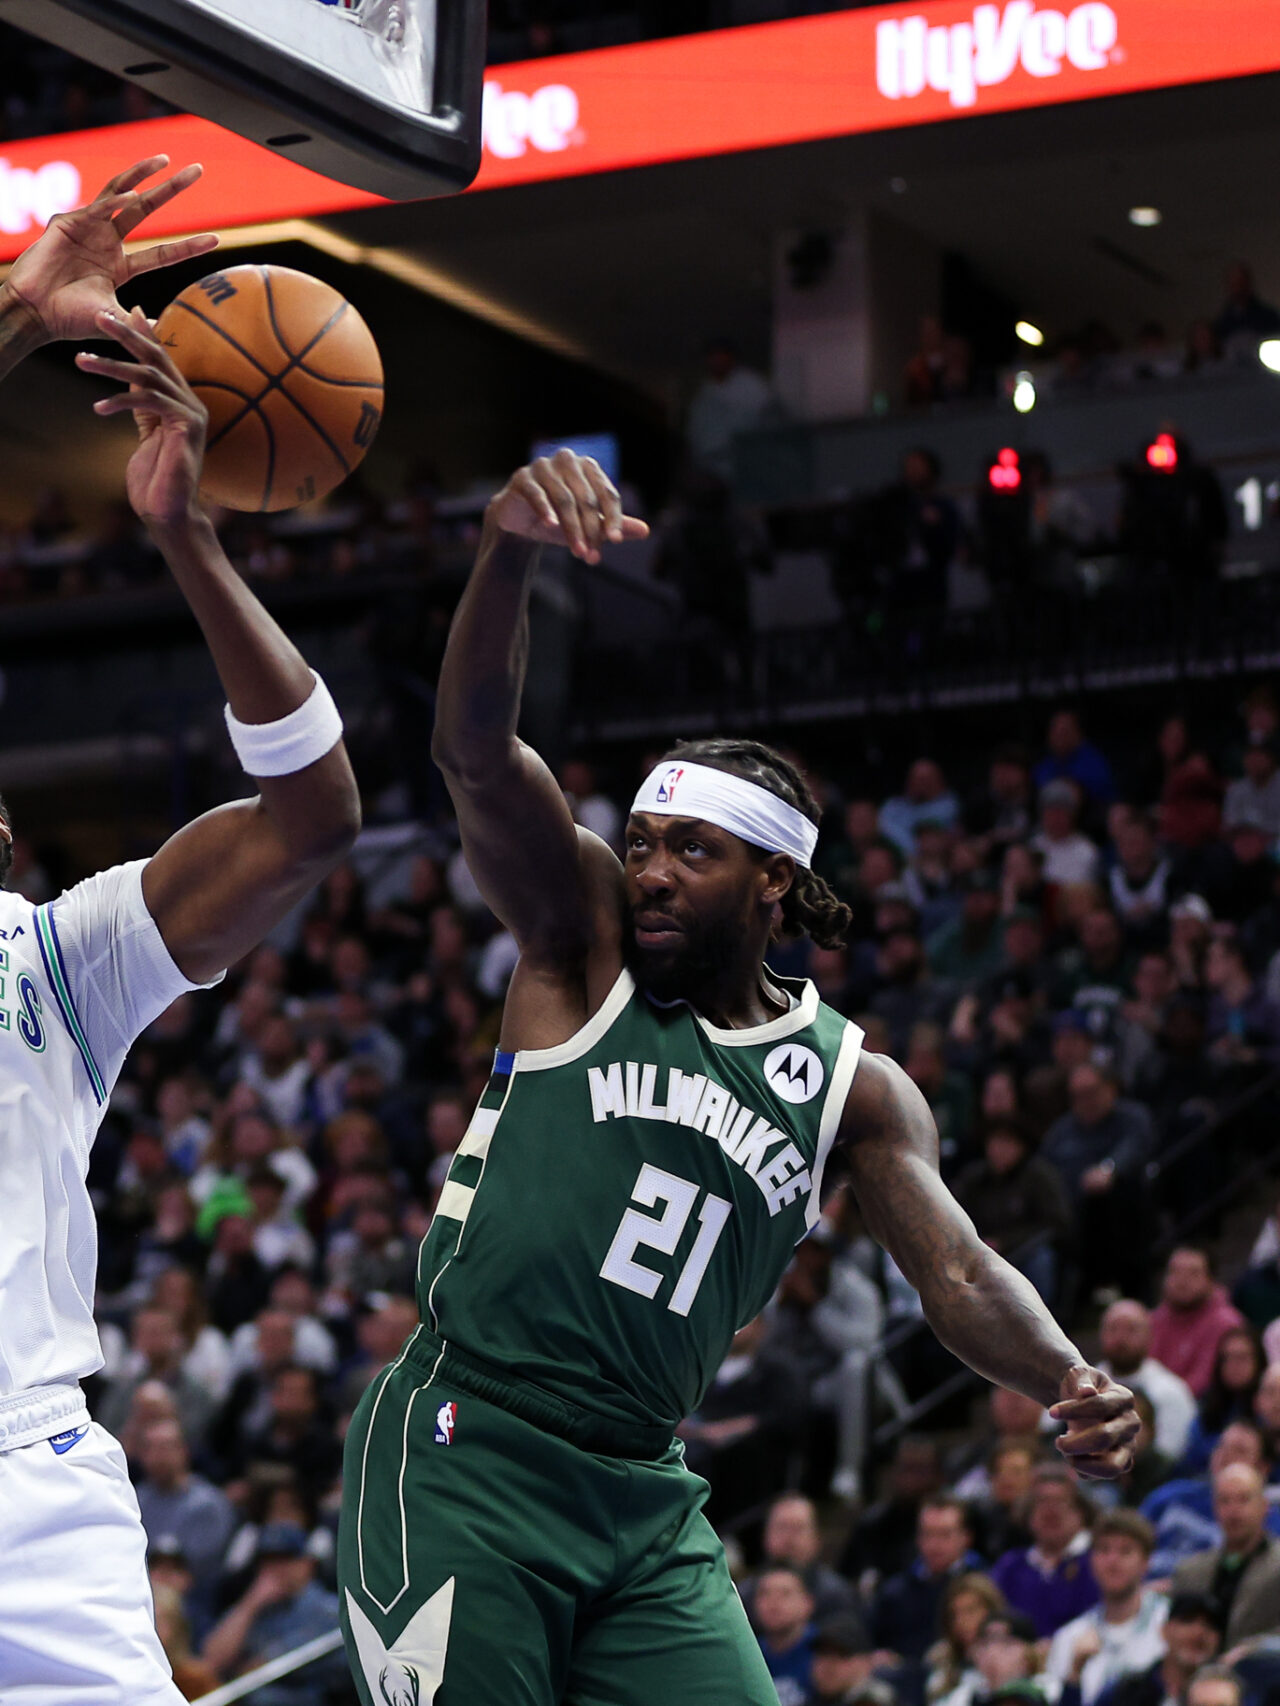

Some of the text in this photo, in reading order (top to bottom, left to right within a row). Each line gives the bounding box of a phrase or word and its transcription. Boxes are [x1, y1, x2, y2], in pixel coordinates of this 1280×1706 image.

[876, 0, 1118, 107] HyVee
[588, 1062, 812, 1218] MILWAUKEE
[599, 1162, 732, 1317] 21
